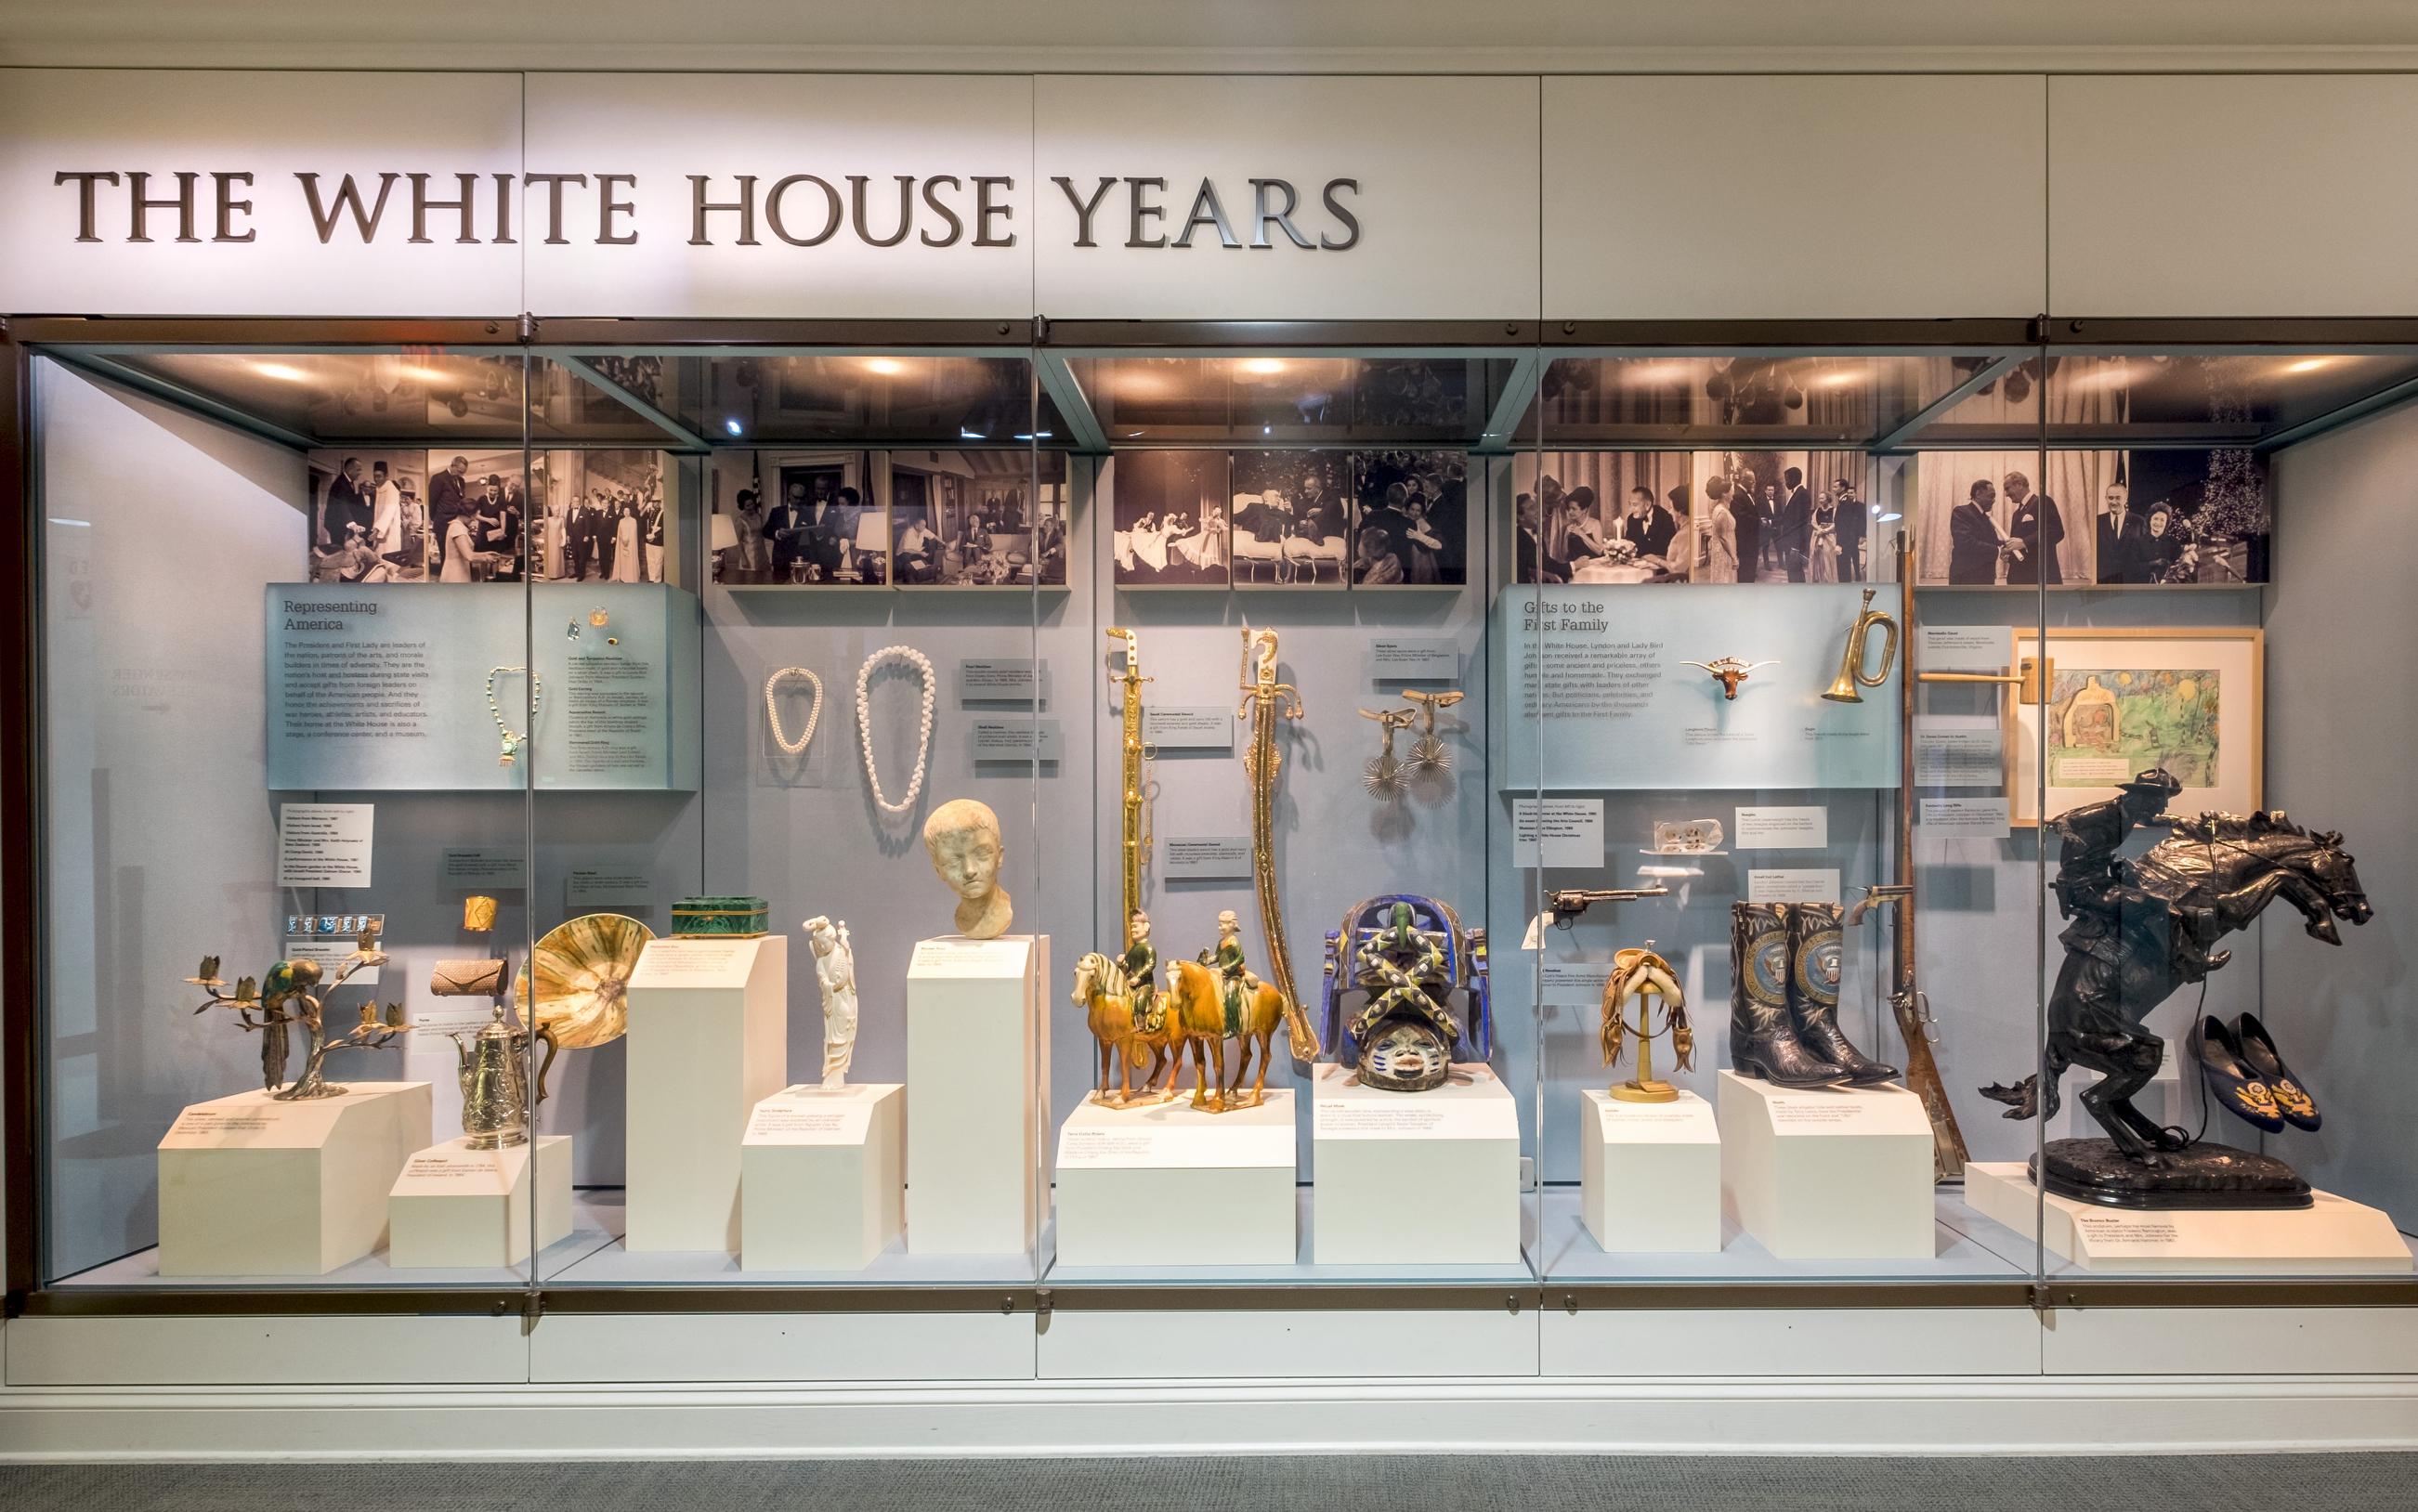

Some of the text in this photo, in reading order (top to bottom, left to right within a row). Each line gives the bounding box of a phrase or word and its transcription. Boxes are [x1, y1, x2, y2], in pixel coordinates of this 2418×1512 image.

[55, 171, 1361, 252] THE WHITE HOUSE YEARS
[283, 600, 377, 615] Representing
[1563, 603, 1576, 614] to
[1582, 601, 1604, 614] the
[283, 619, 343, 631] America
[1561, 619, 1609, 632] Family
